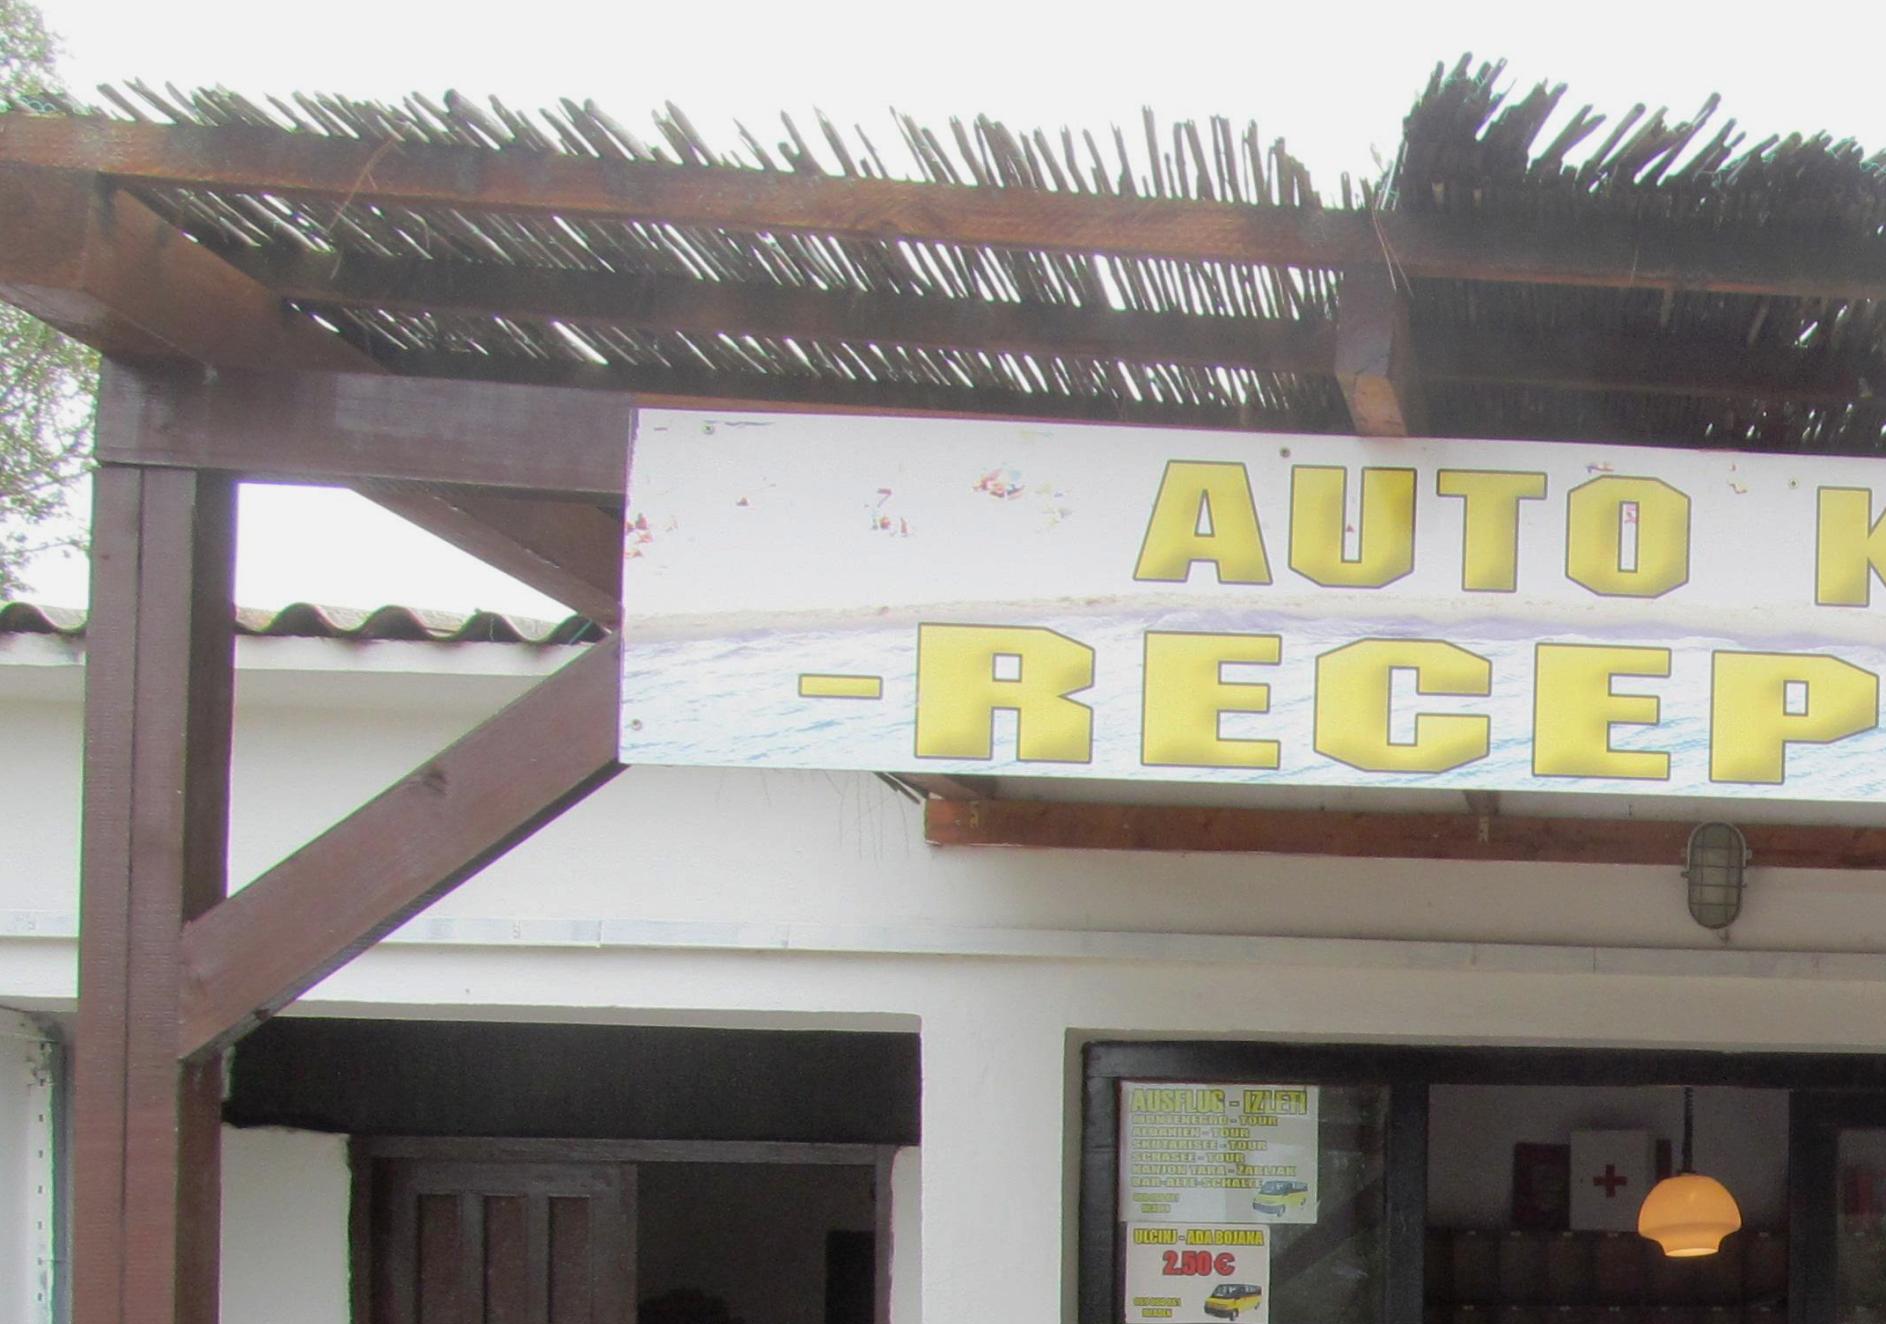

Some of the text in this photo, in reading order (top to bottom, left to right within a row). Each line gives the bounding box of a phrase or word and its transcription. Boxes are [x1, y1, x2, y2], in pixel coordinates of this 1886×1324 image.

[1132, 459, 1692, 598] AUTO
[1243, 1090, 1307, 1114] IZLETI
[1238, 1115, 1278, 1126] TOUR
[1211, 1127, 1250, 1138] TOUR
[1228, 1140, 1267, 1150] TOUR
[1207, 1152, 1246, 1163] TOUR
[1133, 1228, 1177, 1244] ULCINJ
[1186, 1229, 1212, 1245] ADA
[1215, 1229, 1264, 1246] BOJANA
